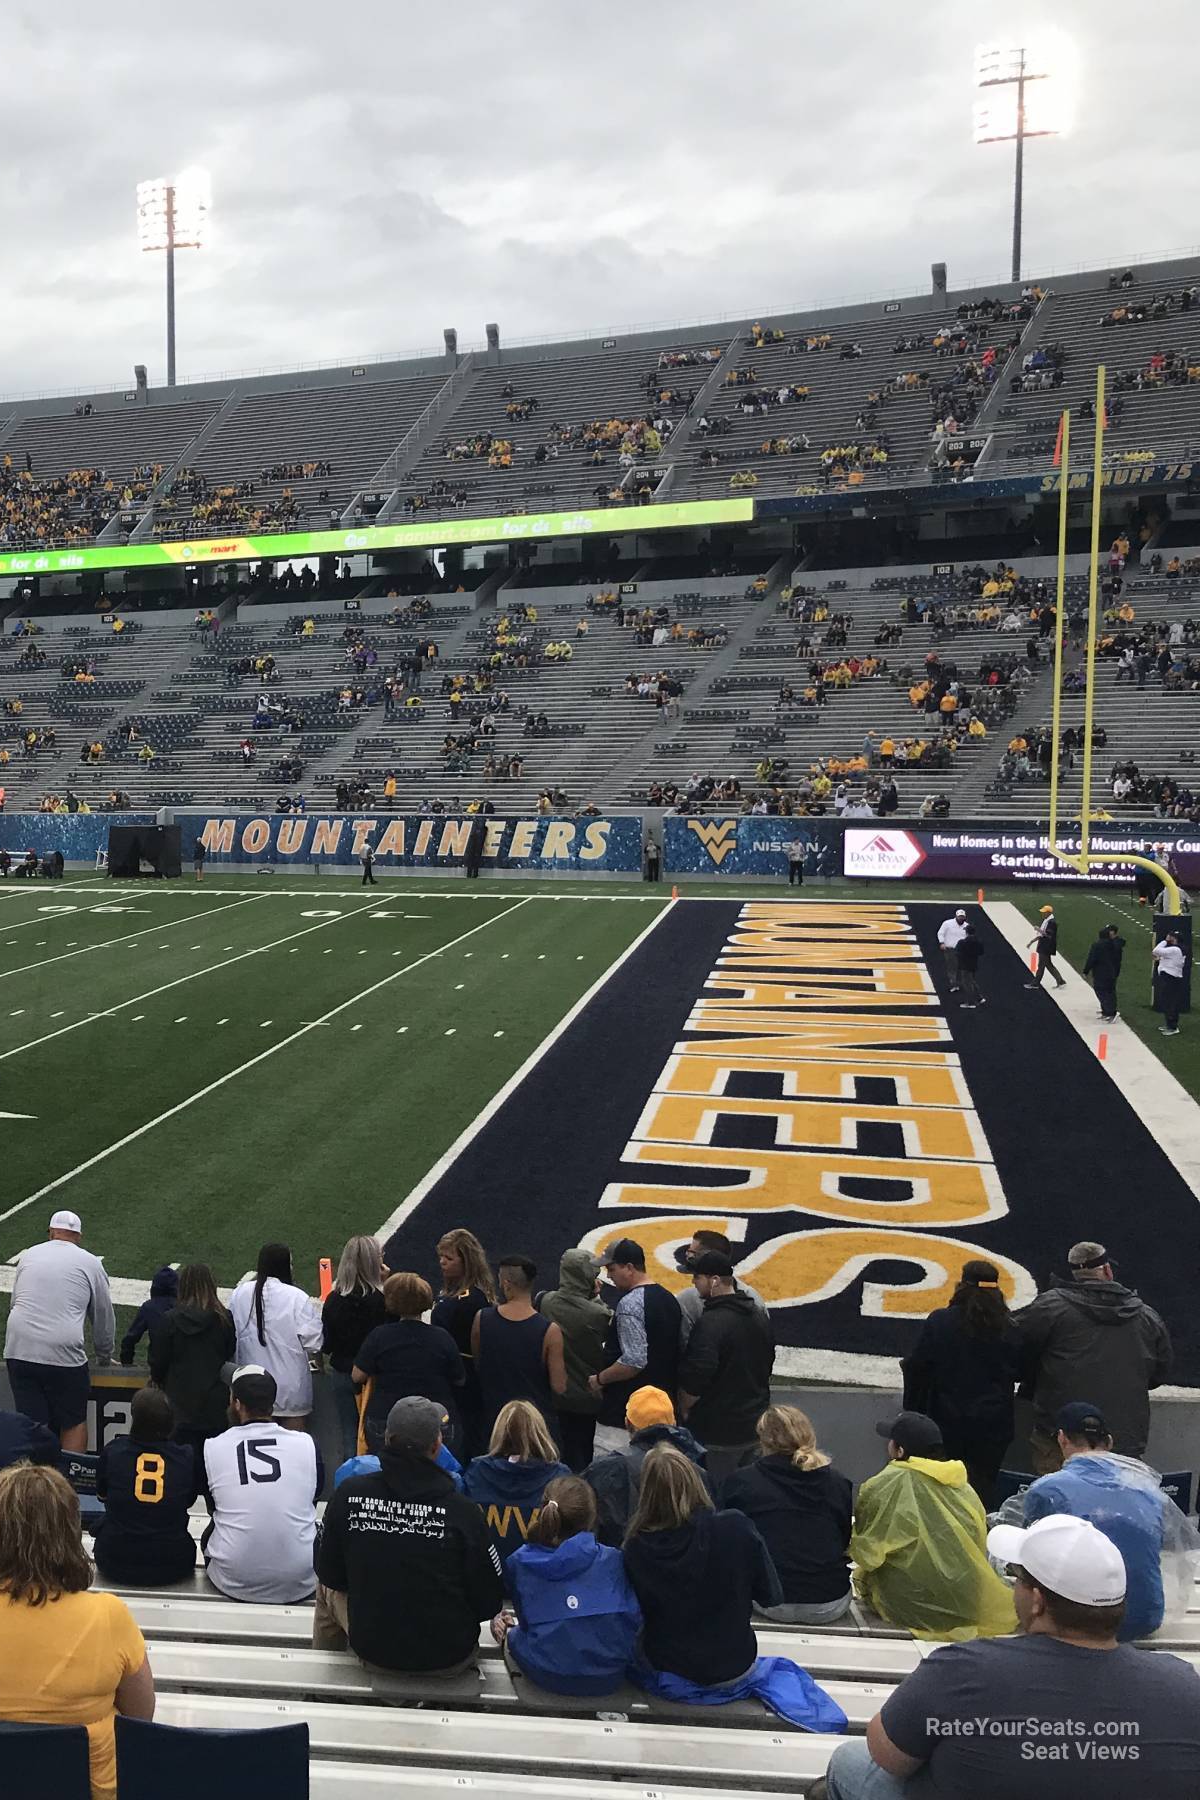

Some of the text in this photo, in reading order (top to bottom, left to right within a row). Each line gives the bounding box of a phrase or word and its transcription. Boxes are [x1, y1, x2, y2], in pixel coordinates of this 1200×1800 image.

[1162, 463, 1193, 481] 75
[10, 557, 30, 571] for
[622, 585, 634, 593] 103
[346, 601, 358, 609] 104
[201, 818, 612, 860] MOUNTAINEERS
[752, 841, 820, 853] NISSN
[932, 834, 958, 848] New
[960, 835, 1000, 849] Homes
[1001, 836, 1014, 849] in
[1015, 836, 1037, 849] the
[1039, 836, 1074, 850] Hart
[990, 853, 1055, 870] Starting
[576, 903, 1038, 1318] MOUNTAINEERS
[235, 1438, 283, 1486] 15
[134, 1452, 165, 1504] 8
[347, 1496, 446, 1515] STAY BACK 100 METERS OR
[377, 1504, 394, 1514] WILL
[397, 1507, 406, 1515] BE
[409, 1508, 429, 1518] SHOT
